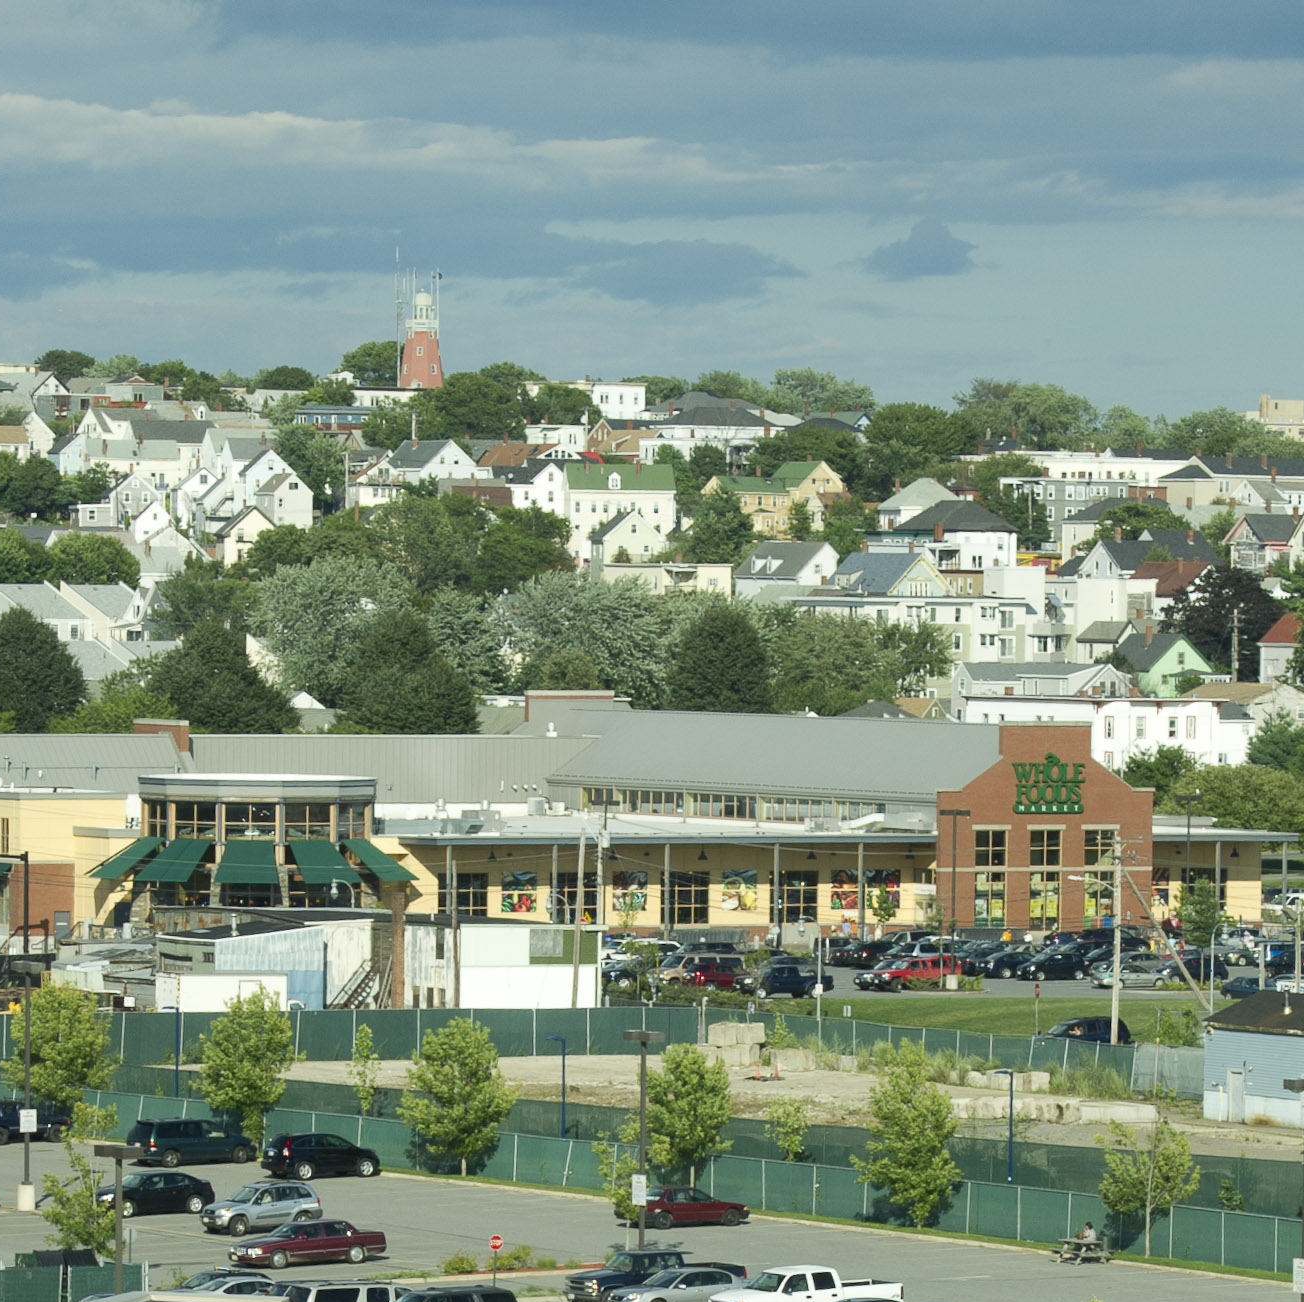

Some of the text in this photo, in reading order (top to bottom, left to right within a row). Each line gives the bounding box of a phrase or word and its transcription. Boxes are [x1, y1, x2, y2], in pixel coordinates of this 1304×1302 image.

[1012, 761, 1086, 783] WHOLE
[1016, 783, 1082, 804] FOODS
[1018, 804, 1079, 812] MARKET
